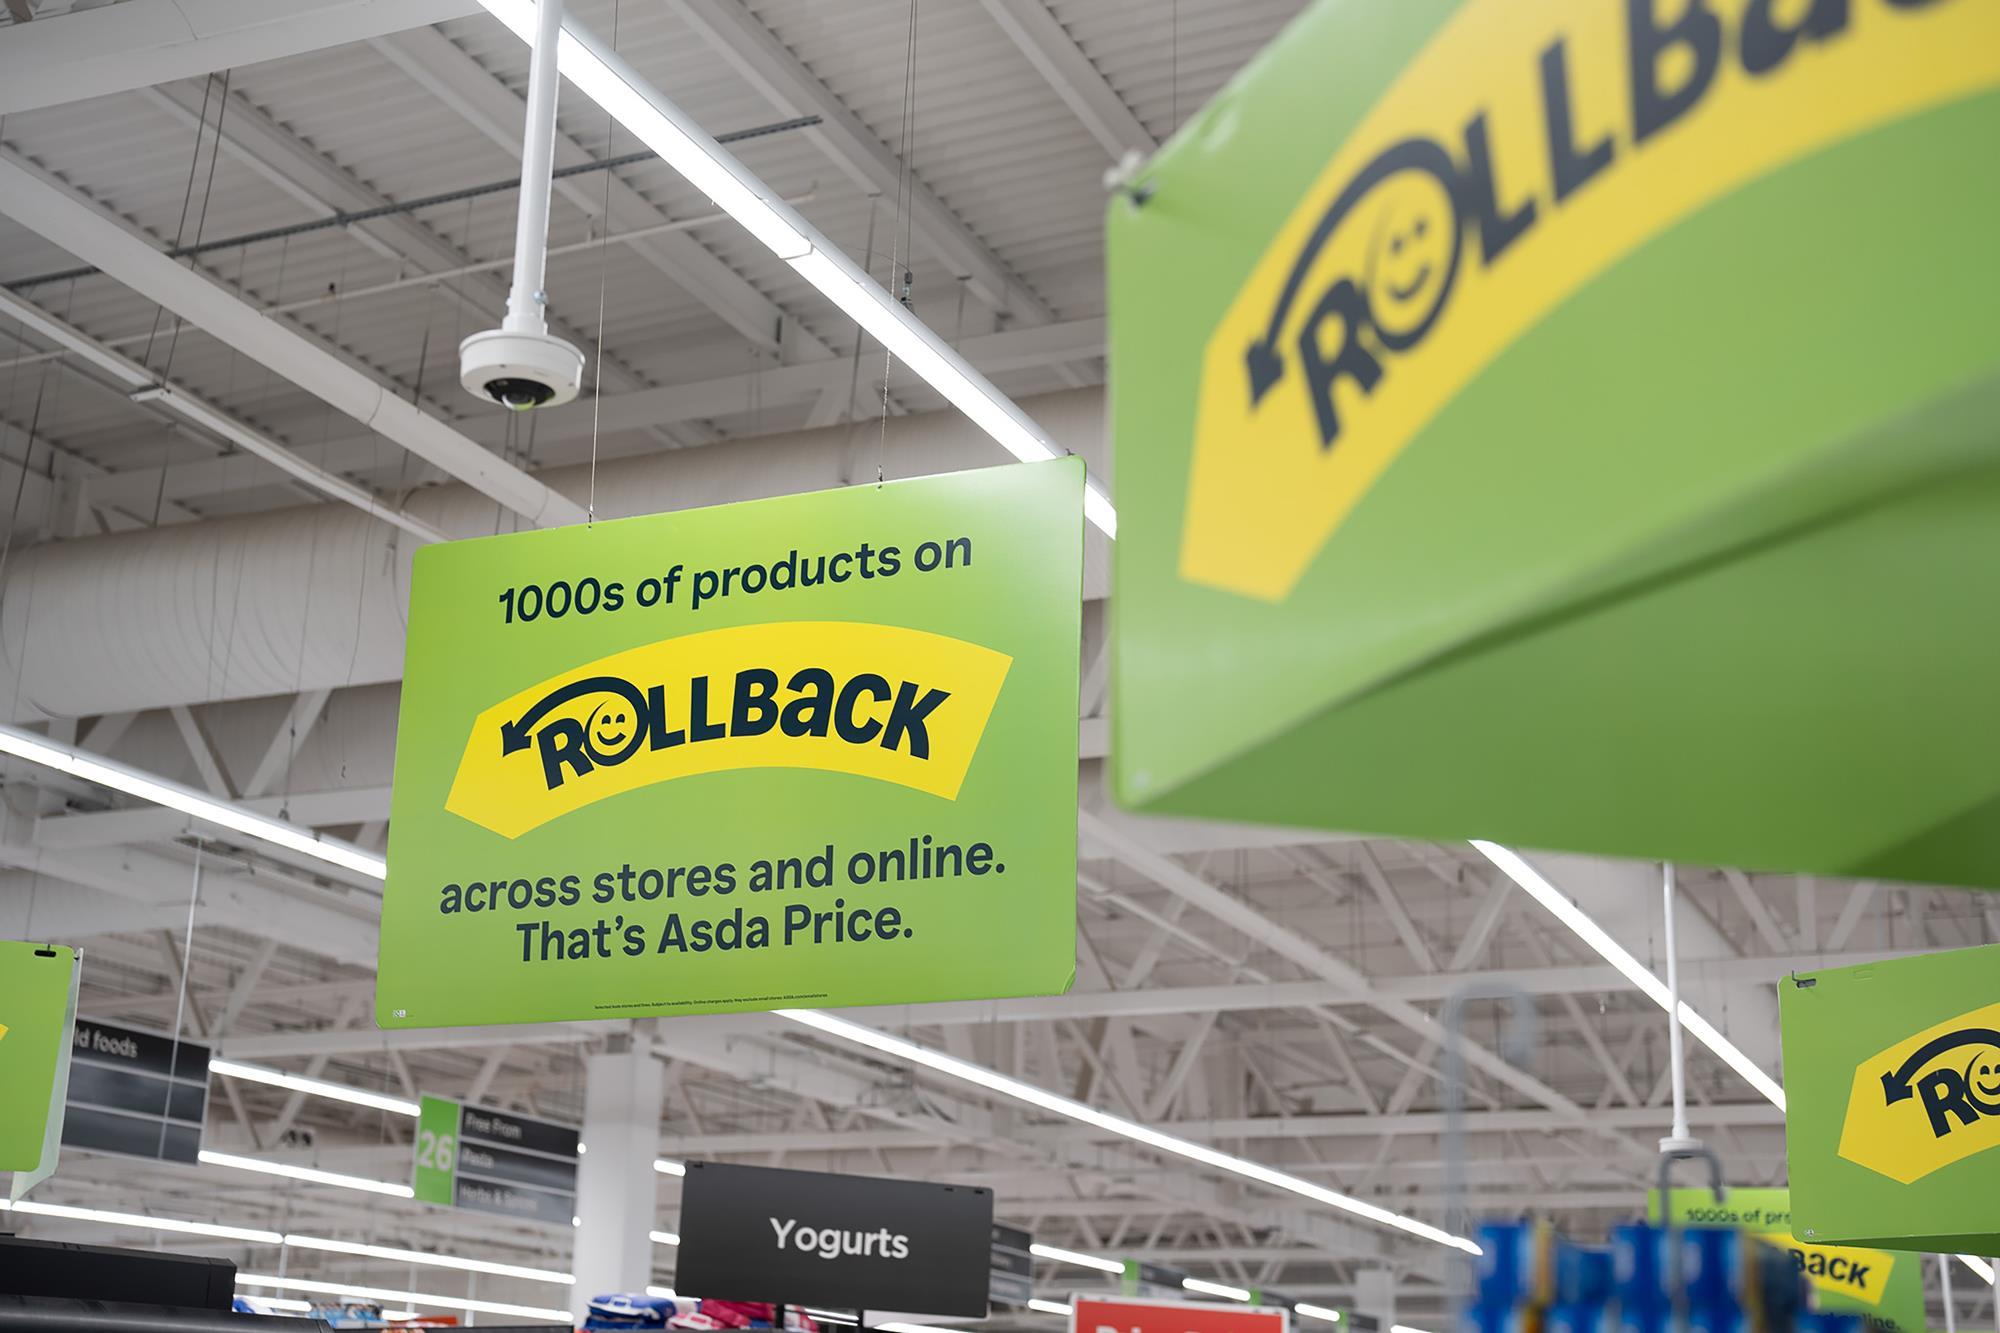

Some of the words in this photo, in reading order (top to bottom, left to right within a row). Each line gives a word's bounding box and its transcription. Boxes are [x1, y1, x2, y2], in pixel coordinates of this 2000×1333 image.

[500, 582, 624, 624] 1000s
[637, 564, 684, 608] of
[691, 542, 901, 610] products
[914, 537, 971, 572] on
[440, 869, 580, 915] across
[592, 863, 737, 904] stores
[749, 845, 834, 893] and
[847, 834, 1005, 885] online.
[656, 907, 769, 954] Asda
[784, 898, 913, 946] Price.
[93, 1029, 138, 1058] foods
[464, 1112, 491, 1131] Free
[416, 1130, 452, 1171] 26
[769, 1217, 909, 1259] Yogurts
